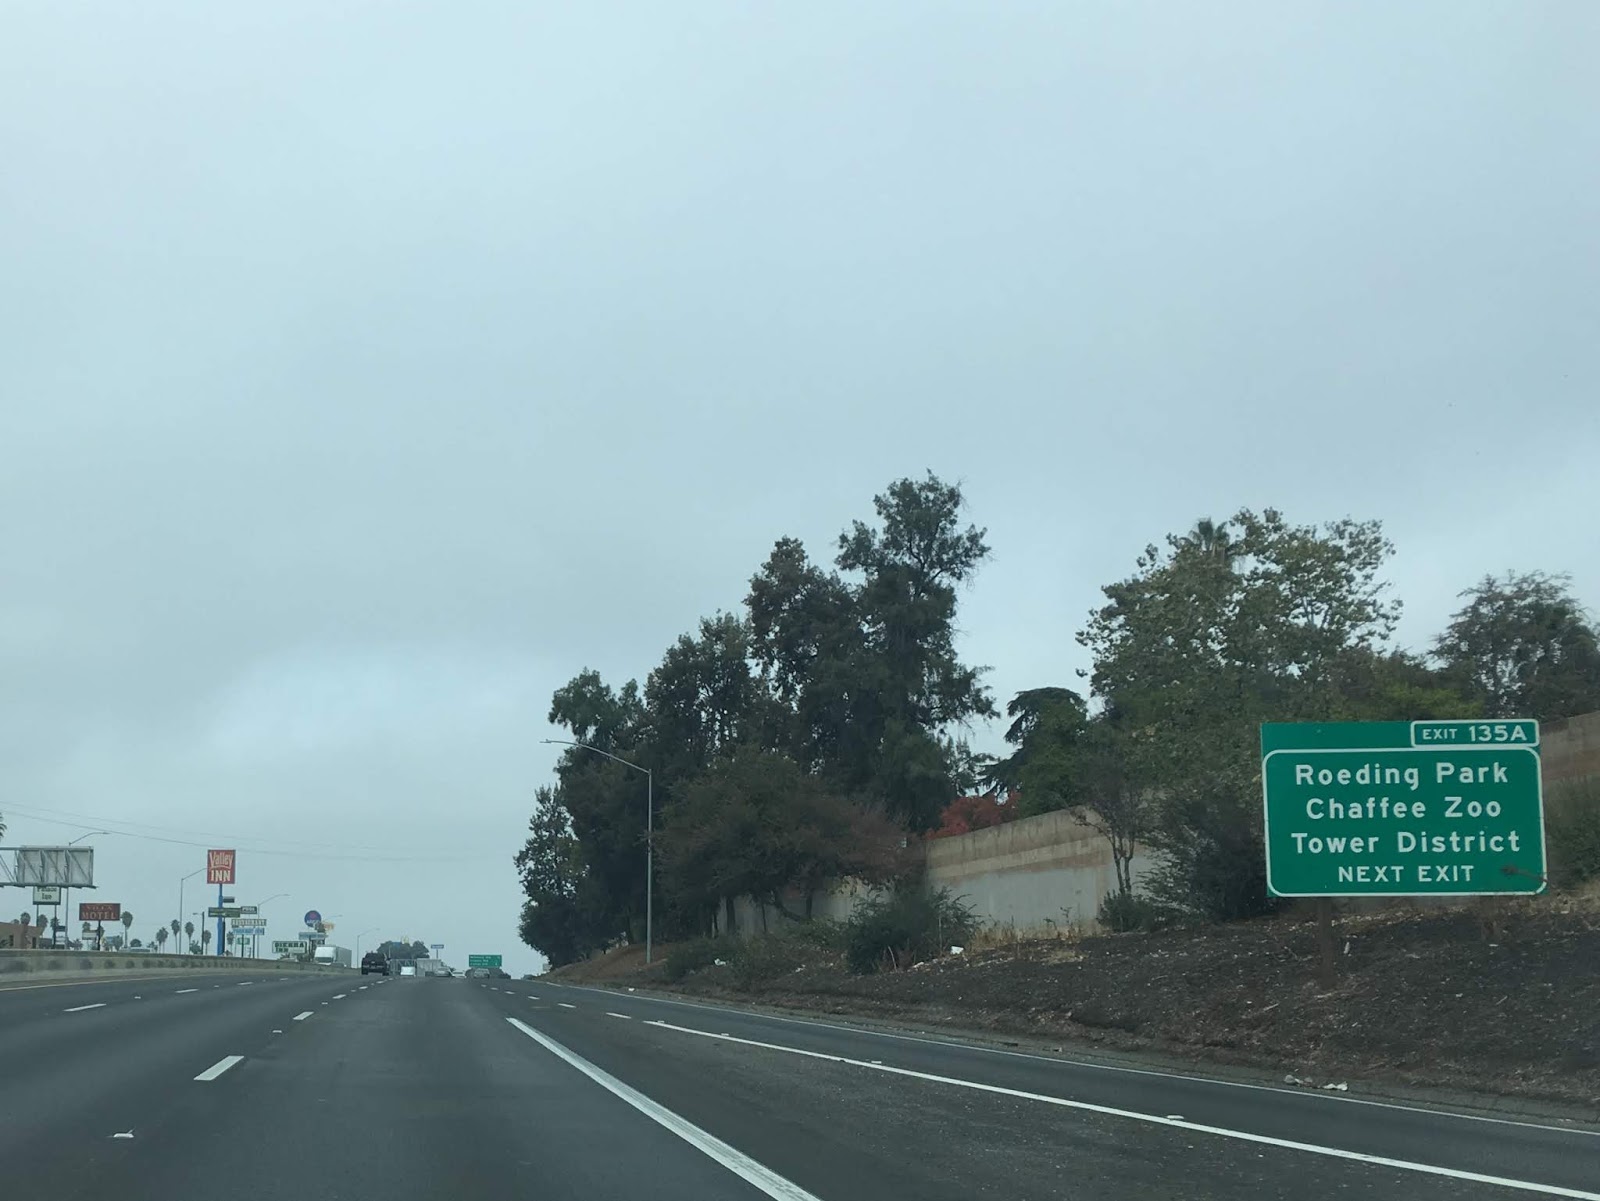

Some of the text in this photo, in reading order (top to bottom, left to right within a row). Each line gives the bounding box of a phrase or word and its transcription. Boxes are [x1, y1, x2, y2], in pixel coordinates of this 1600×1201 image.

[1422, 725, 1527, 742] EXIT 135A
[1295, 761, 1508, 791] Roeding Park
[1306, 796, 1501, 820] Chaffee Zoo
[1291, 830, 1520, 854] Tower District
[209, 852, 233, 869] Valley
[210, 870, 231, 882] INN
[1338, 865, 1474, 883] NEXT EXIT
